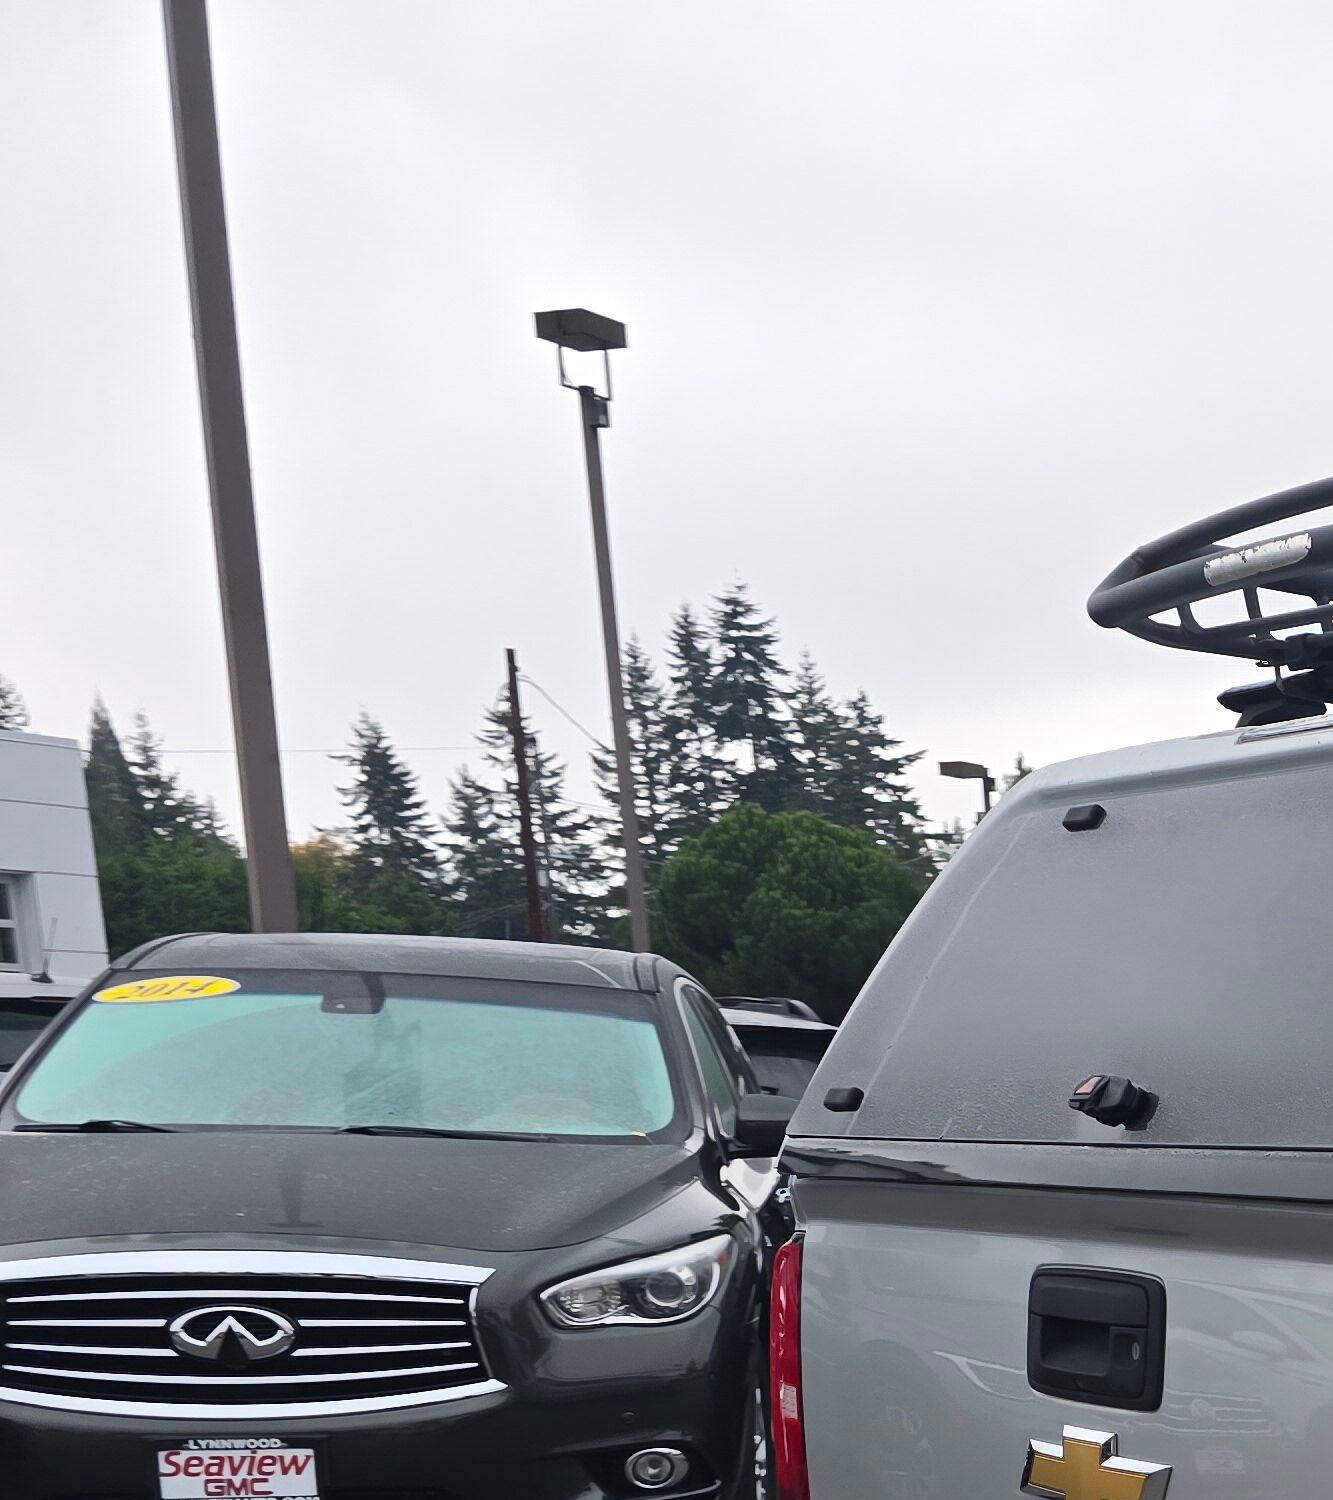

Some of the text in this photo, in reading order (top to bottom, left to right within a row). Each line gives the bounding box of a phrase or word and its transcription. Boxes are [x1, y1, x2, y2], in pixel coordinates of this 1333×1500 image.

[187, 1438, 282, 1450] LYNNWOOD
[159, 1449, 313, 1478] Seaview
[204, 1477, 273, 1497] GMC
